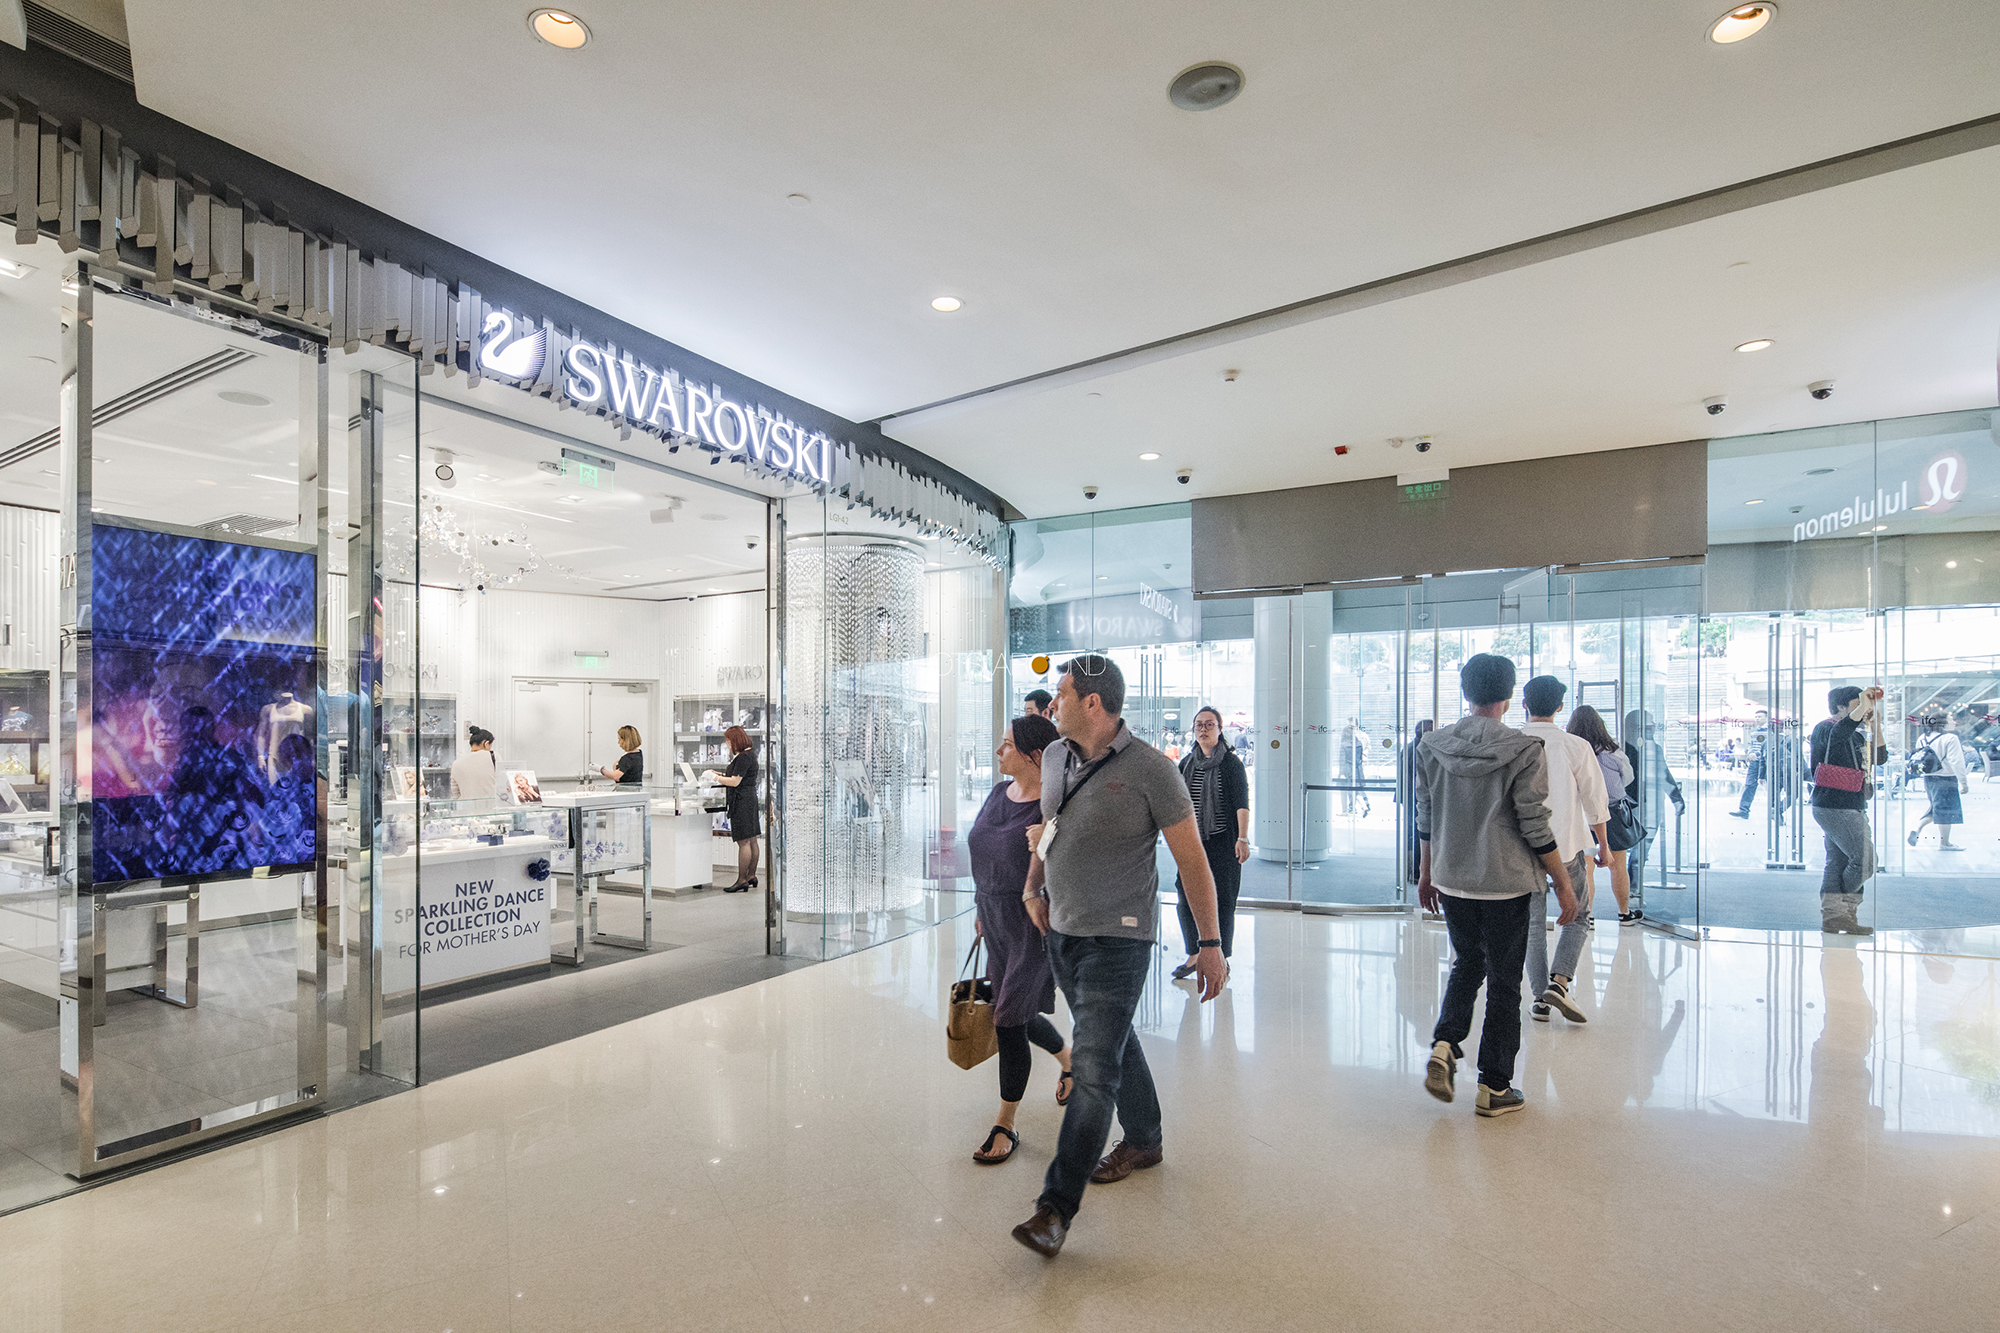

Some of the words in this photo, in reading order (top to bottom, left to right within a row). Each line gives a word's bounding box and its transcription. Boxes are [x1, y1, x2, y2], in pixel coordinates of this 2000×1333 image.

[565, 343, 831, 482] SWAROVSKI
[1405, 482, 1441, 494] 安全出口
[1410, 491, 1436, 499] EXIT
[1784, 717, 1798, 727] ifc
[1921, 715, 1937, 725] ifc
[455, 879, 494, 898] NEW
[394, 896, 489, 924] SPARKLING
[494, 888, 544, 908] DANCE
[424, 907, 521, 936] COLLECTION
[399, 941, 431, 959] FOR
[436, 926, 509, 952] MOTHER'S
[513, 920, 541, 938] DAY
